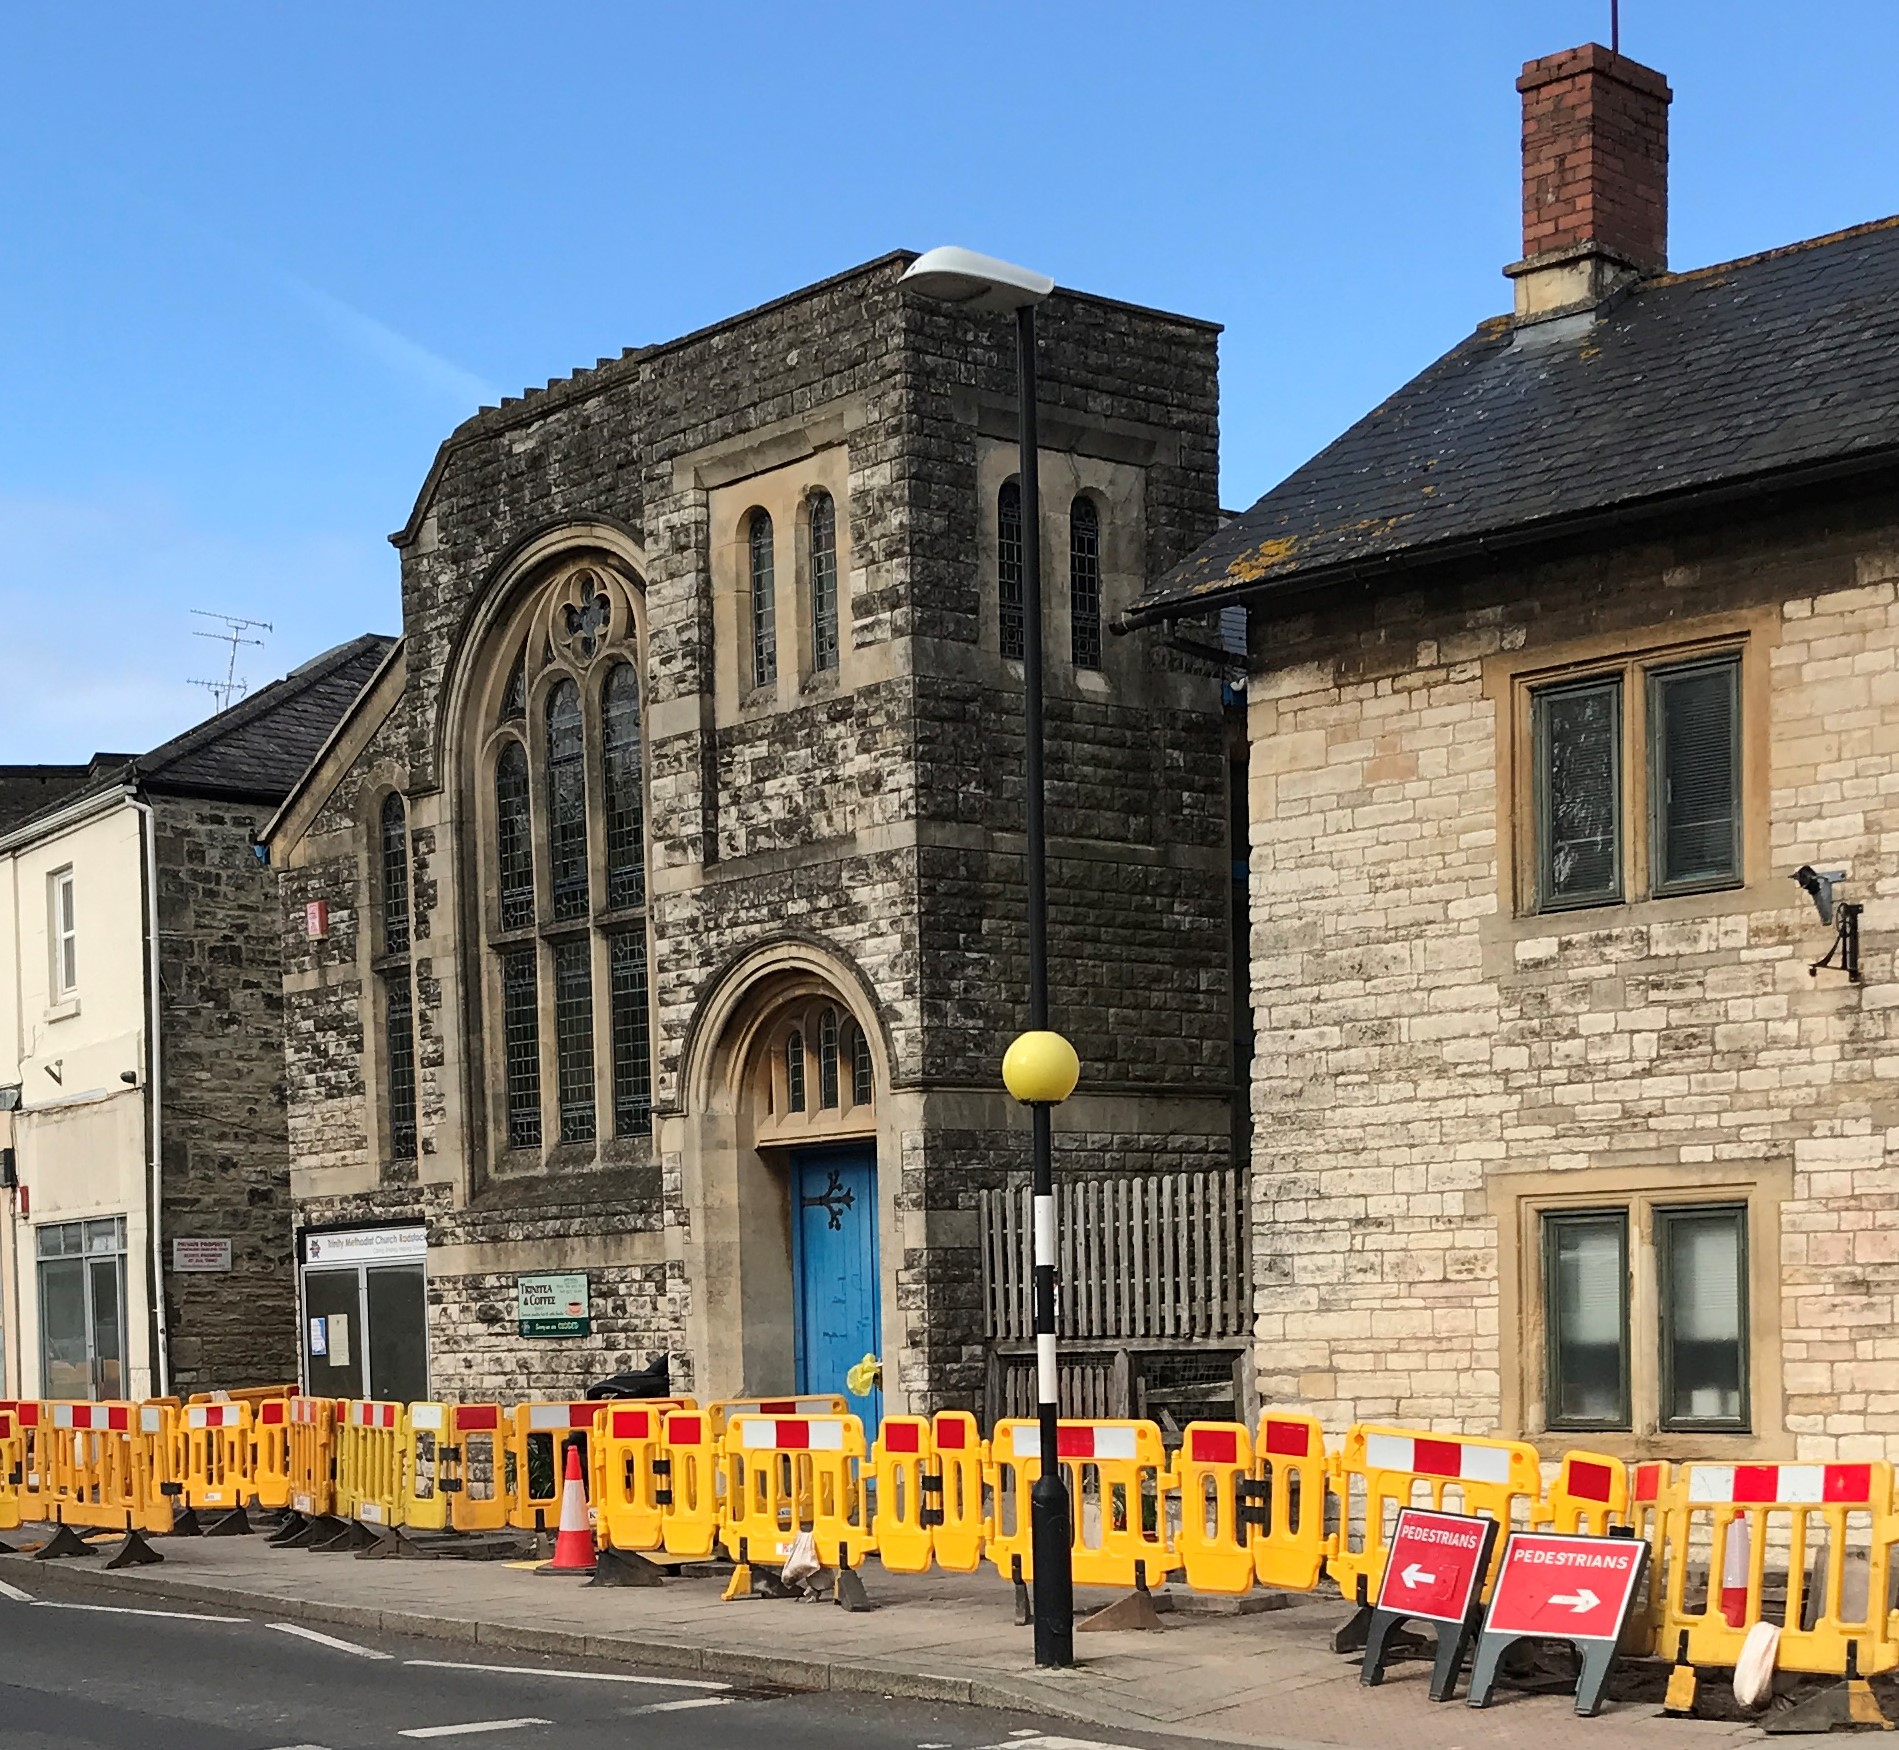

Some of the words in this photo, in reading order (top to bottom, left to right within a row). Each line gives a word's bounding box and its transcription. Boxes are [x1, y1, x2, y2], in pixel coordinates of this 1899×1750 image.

[345, 1236, 374, 1247] Methodist
[375, 1234, 398, 1245] Church
[529, 1294, 556, 1306] COFFEE
[1400, 1524, 1478, 1549] PEDESTRIANS
[1512, 1549, 1630, 1570] PEDESTRIANS
